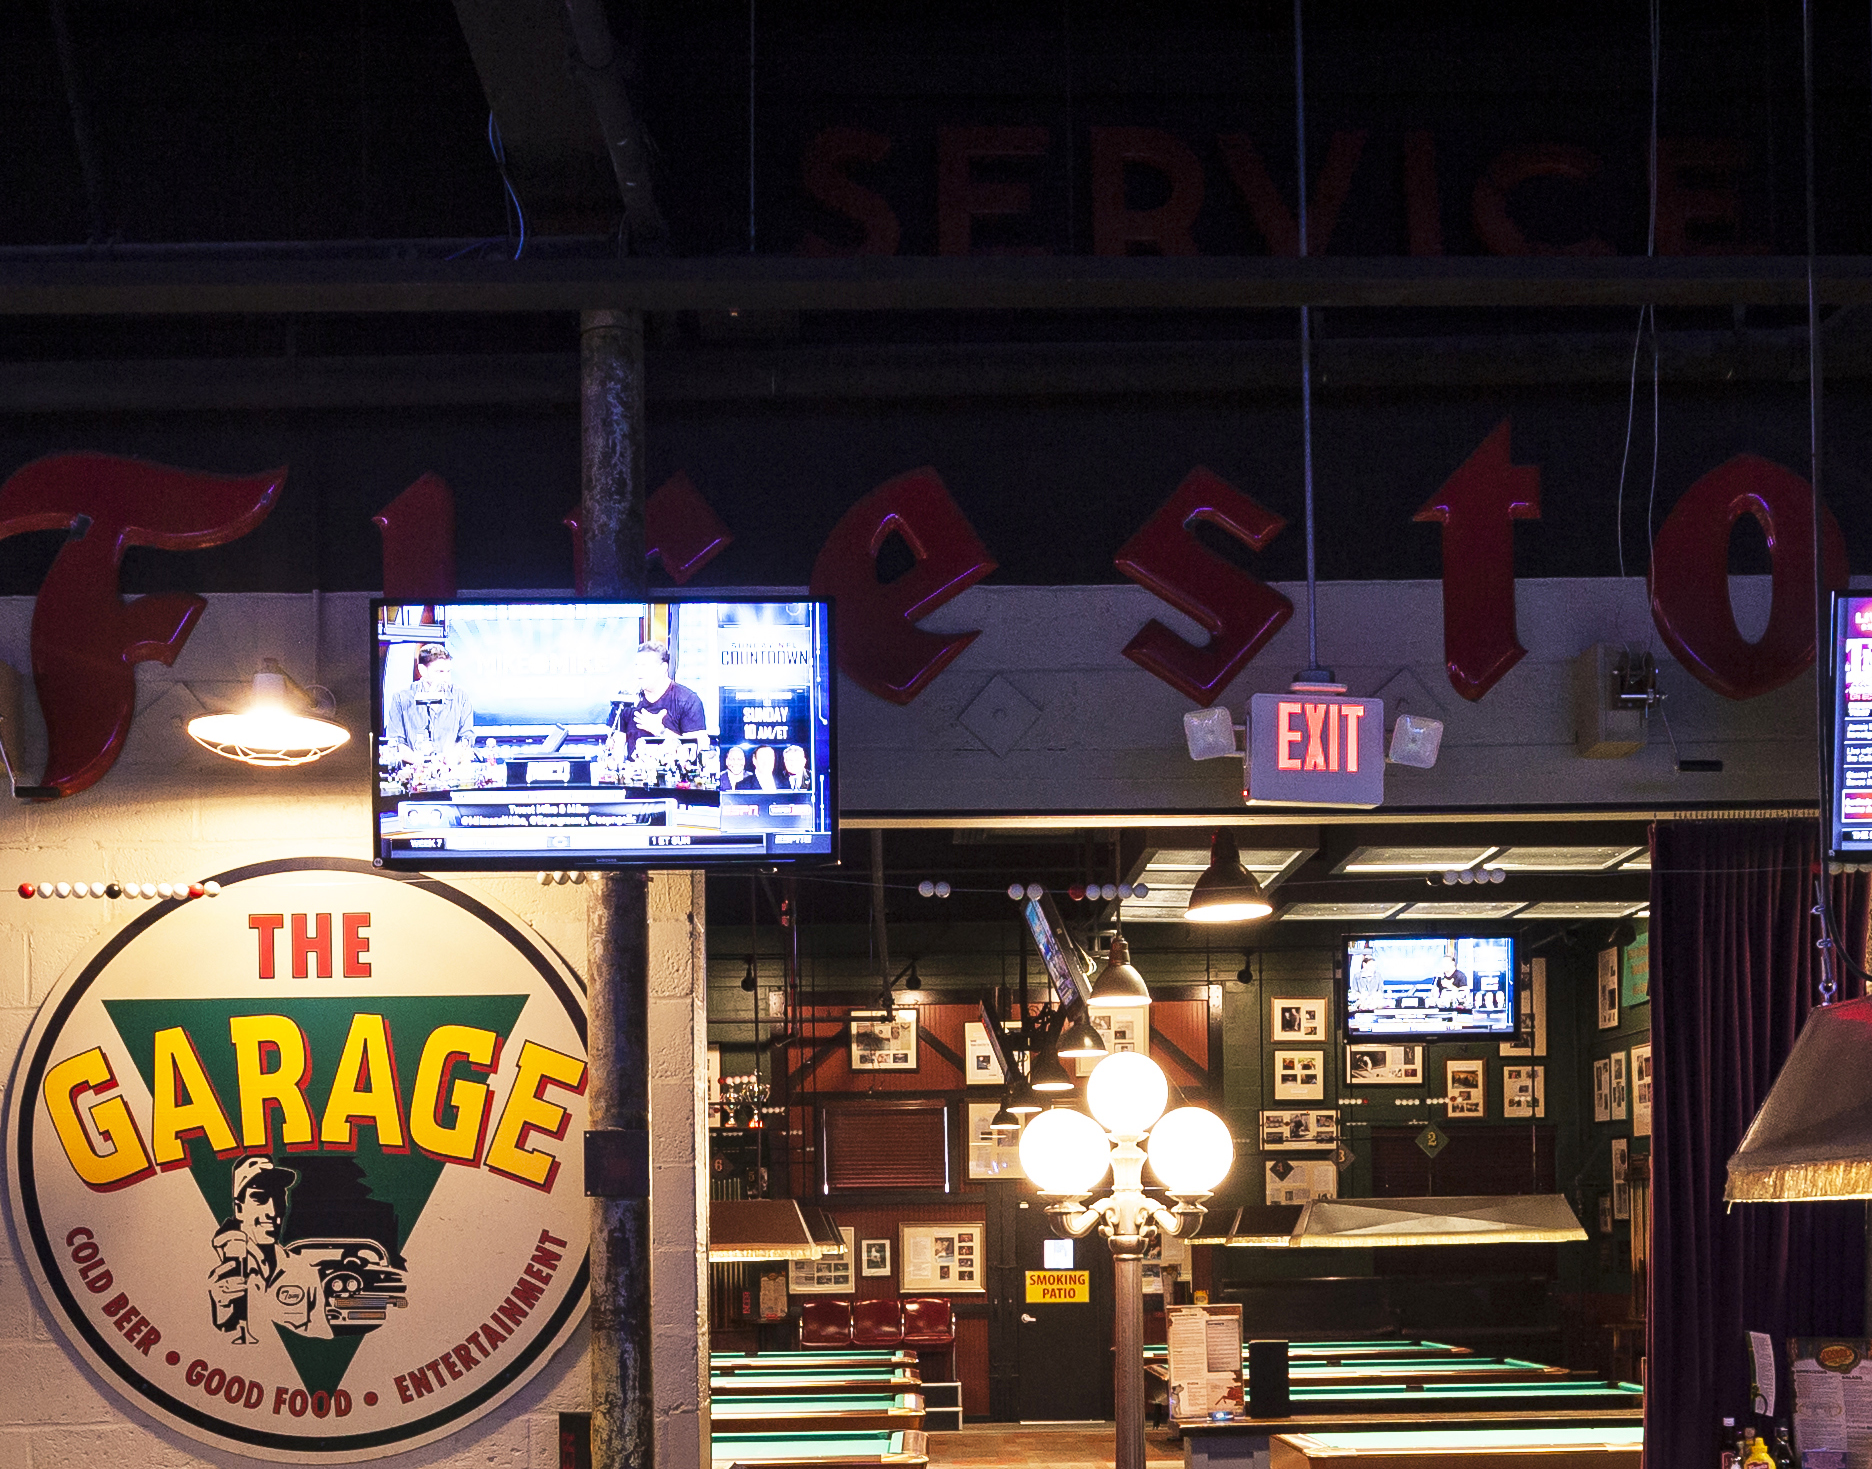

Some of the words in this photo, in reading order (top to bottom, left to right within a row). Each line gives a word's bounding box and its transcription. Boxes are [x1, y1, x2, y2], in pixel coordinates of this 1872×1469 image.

[721, 650, 808, 666] COUNTDOWN
[742, 706, 789, 723] SUNDAY
[1277, 701, 1365, 773] EXIT
[247, 911, 374, 979] THE
[42, 1011, 589, 1195] GARAGE
[714, 1158, 724, 1172] 6
[1029, 1274, 1086, 1286] SMOKING
[1042, 1287, 1076, 1299] PATIO
[64, 1224, 115, 1296] COLD
[102, 1290, 163, 1358] BEER
[185, 1358, 266, 1411] GOOD
[272, 1387, 354, 1419] FOOD
[392, 1227, 570, 1405] ENTERTAINMENT
